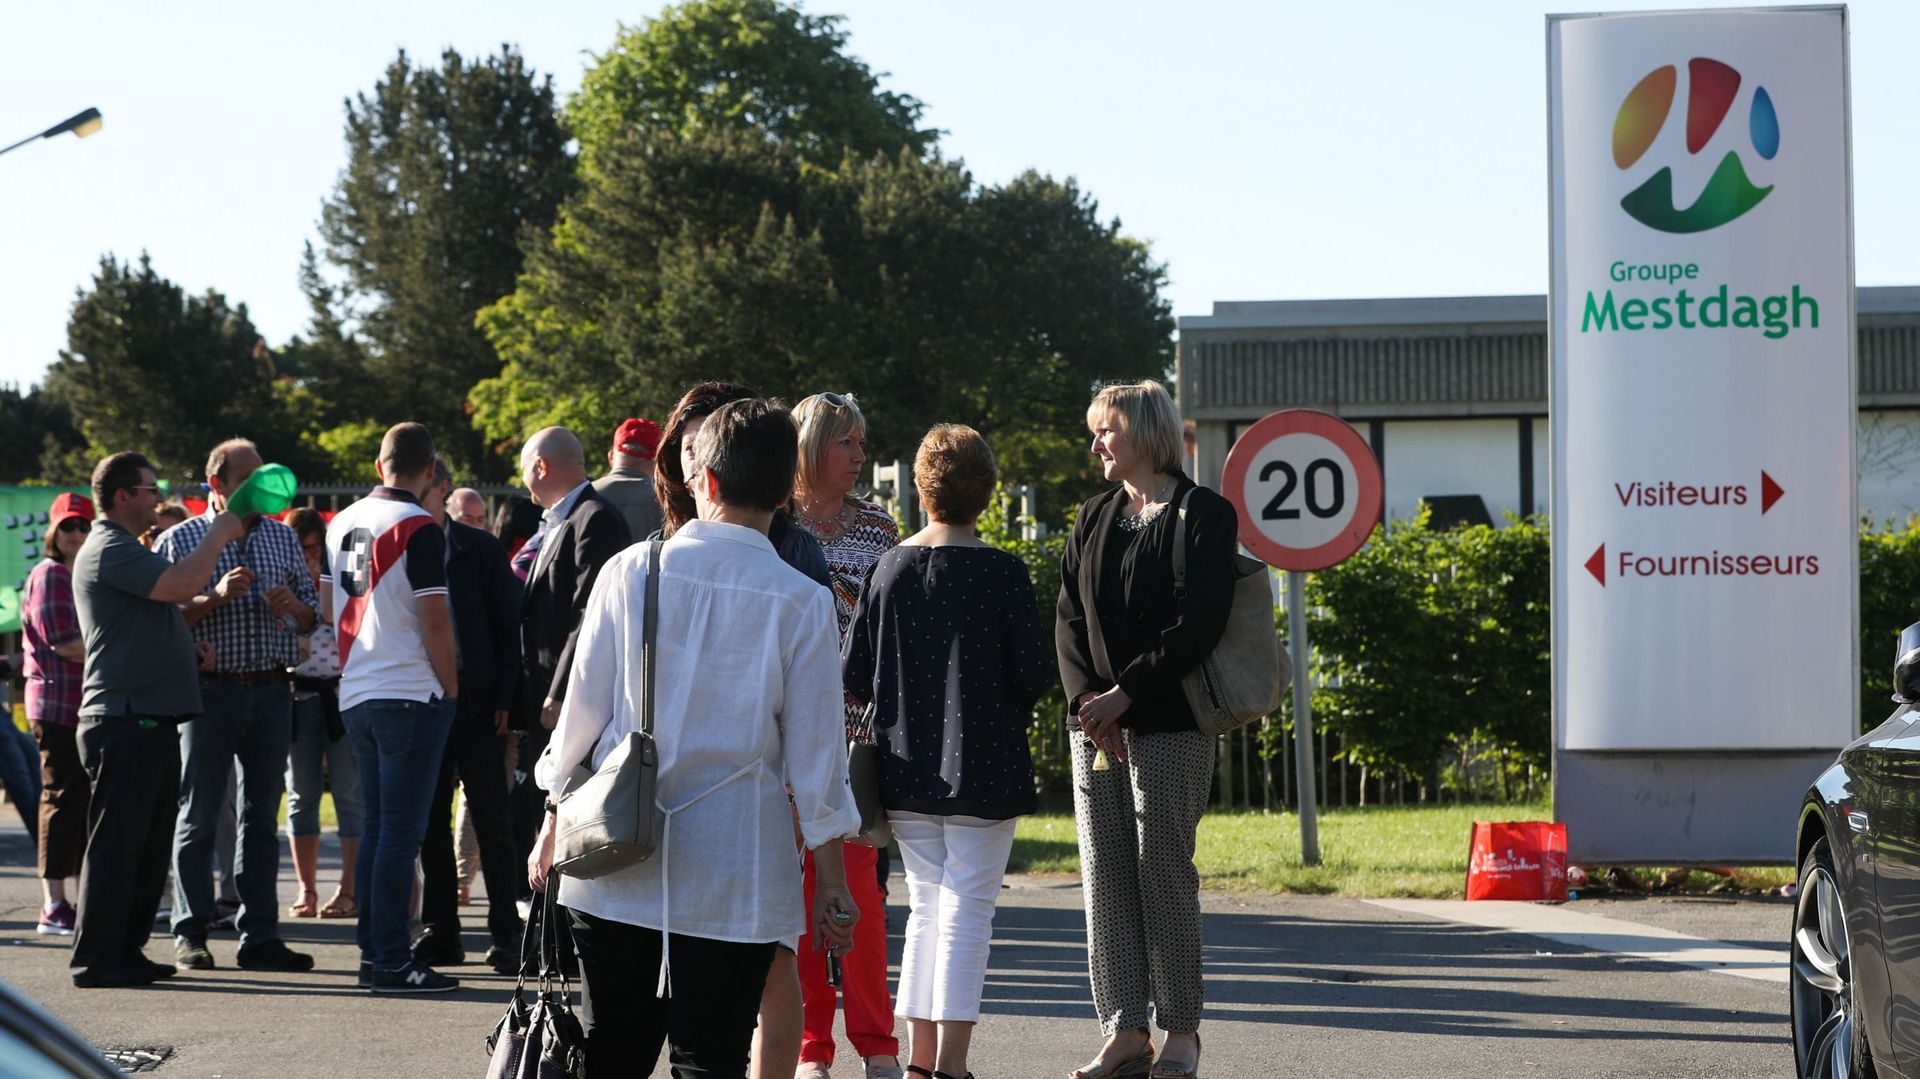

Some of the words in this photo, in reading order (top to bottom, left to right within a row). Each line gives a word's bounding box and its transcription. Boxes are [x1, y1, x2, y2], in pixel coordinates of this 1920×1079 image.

[1609, 261, 1700, 285] Groupe
[1581, 284, 1819, 339] Mestdagh
[1259, 458, 1345, 520] 20
[1614, 481, 1748, 507] Visiteurs
[340, 527, 375, 597] 3
[1619, 550, 1819, 577] Fournisseurs
